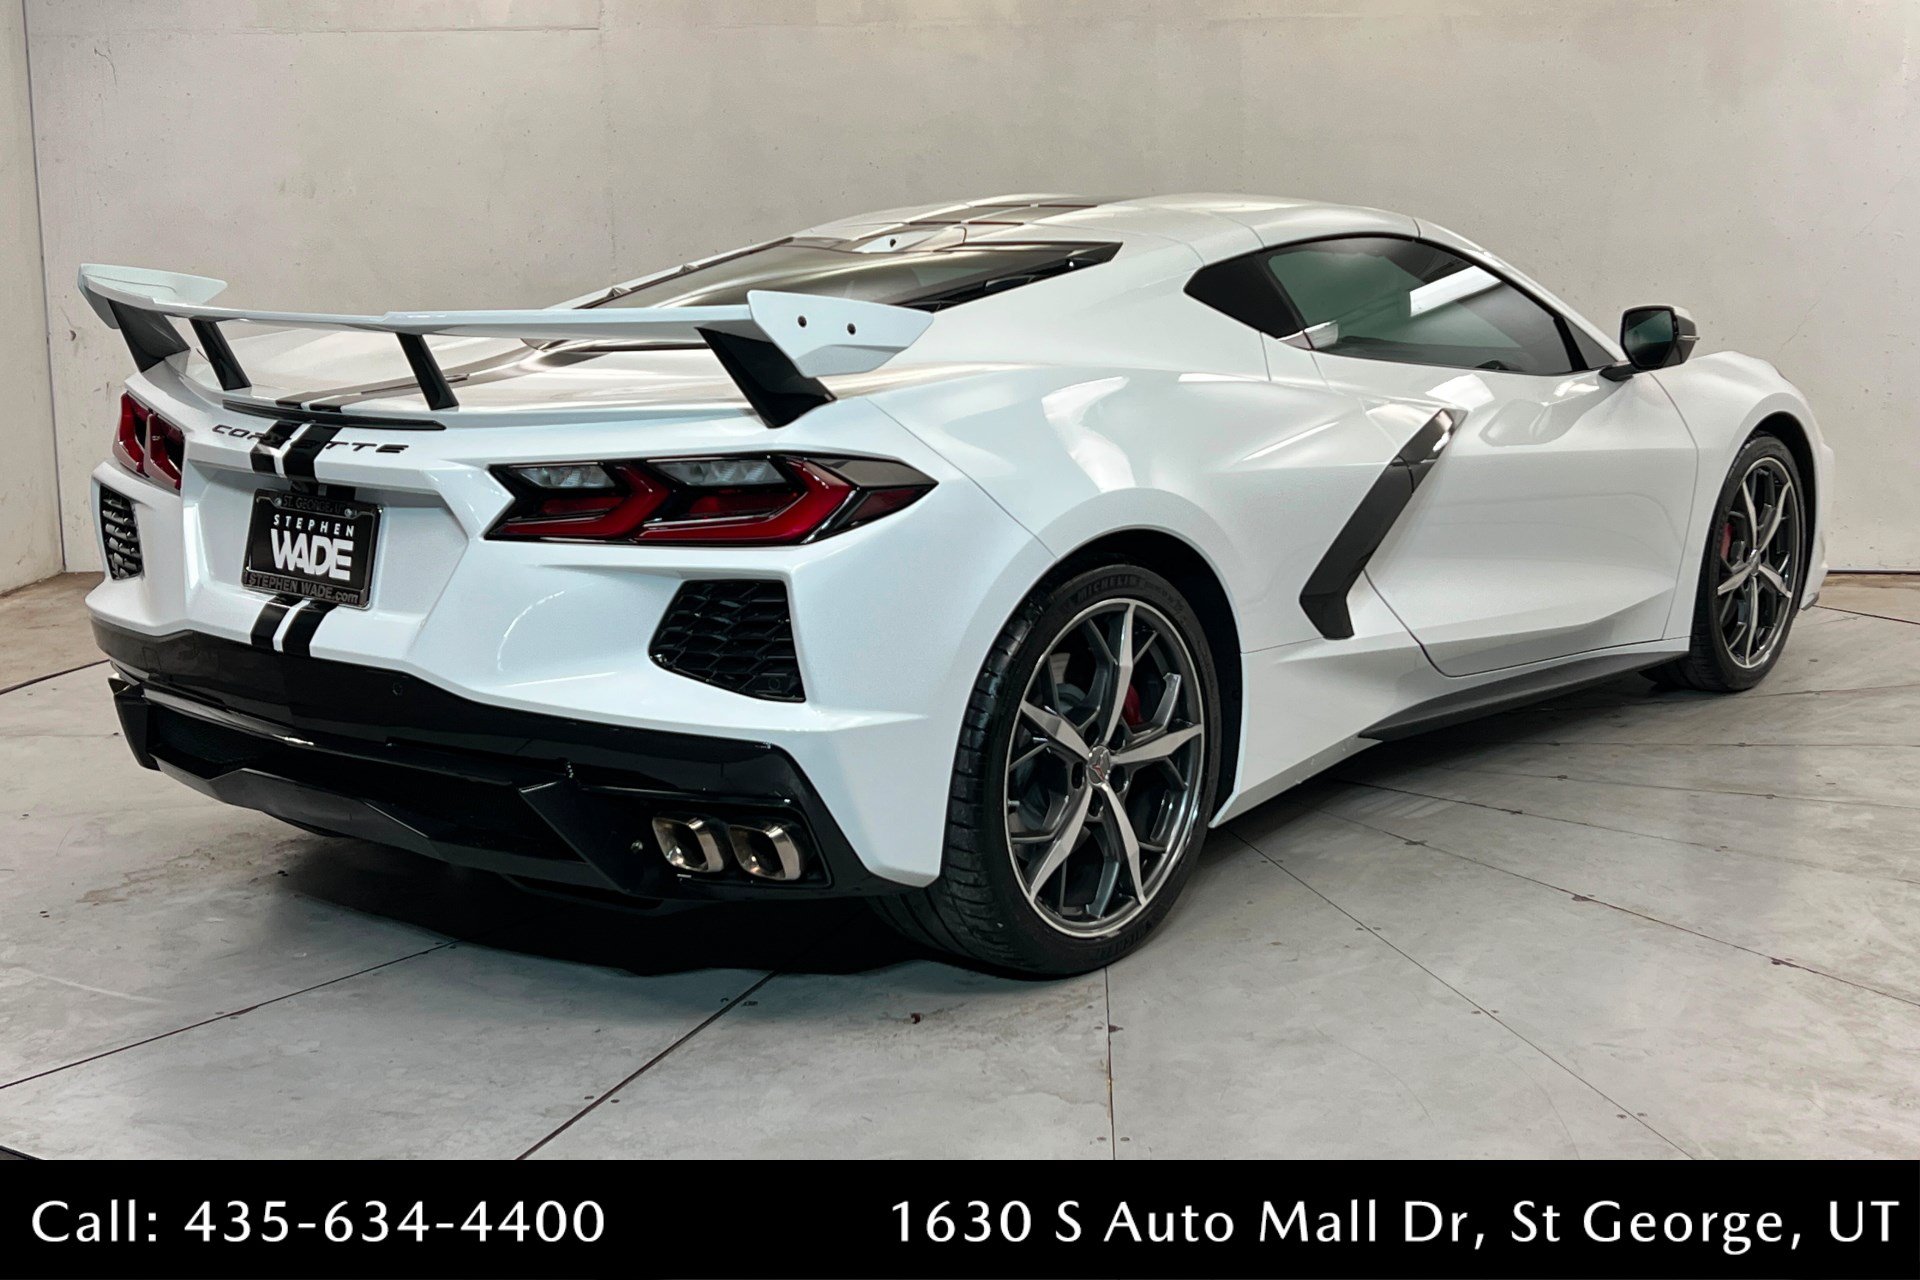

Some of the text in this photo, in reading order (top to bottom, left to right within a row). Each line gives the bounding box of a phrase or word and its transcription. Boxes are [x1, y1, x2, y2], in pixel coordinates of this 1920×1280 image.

[273, 514, 355, 537] STEPHEN
[270, 528, 354, 581] WADE
[249, 573, 359, 604] STEPHEN WADE.com
